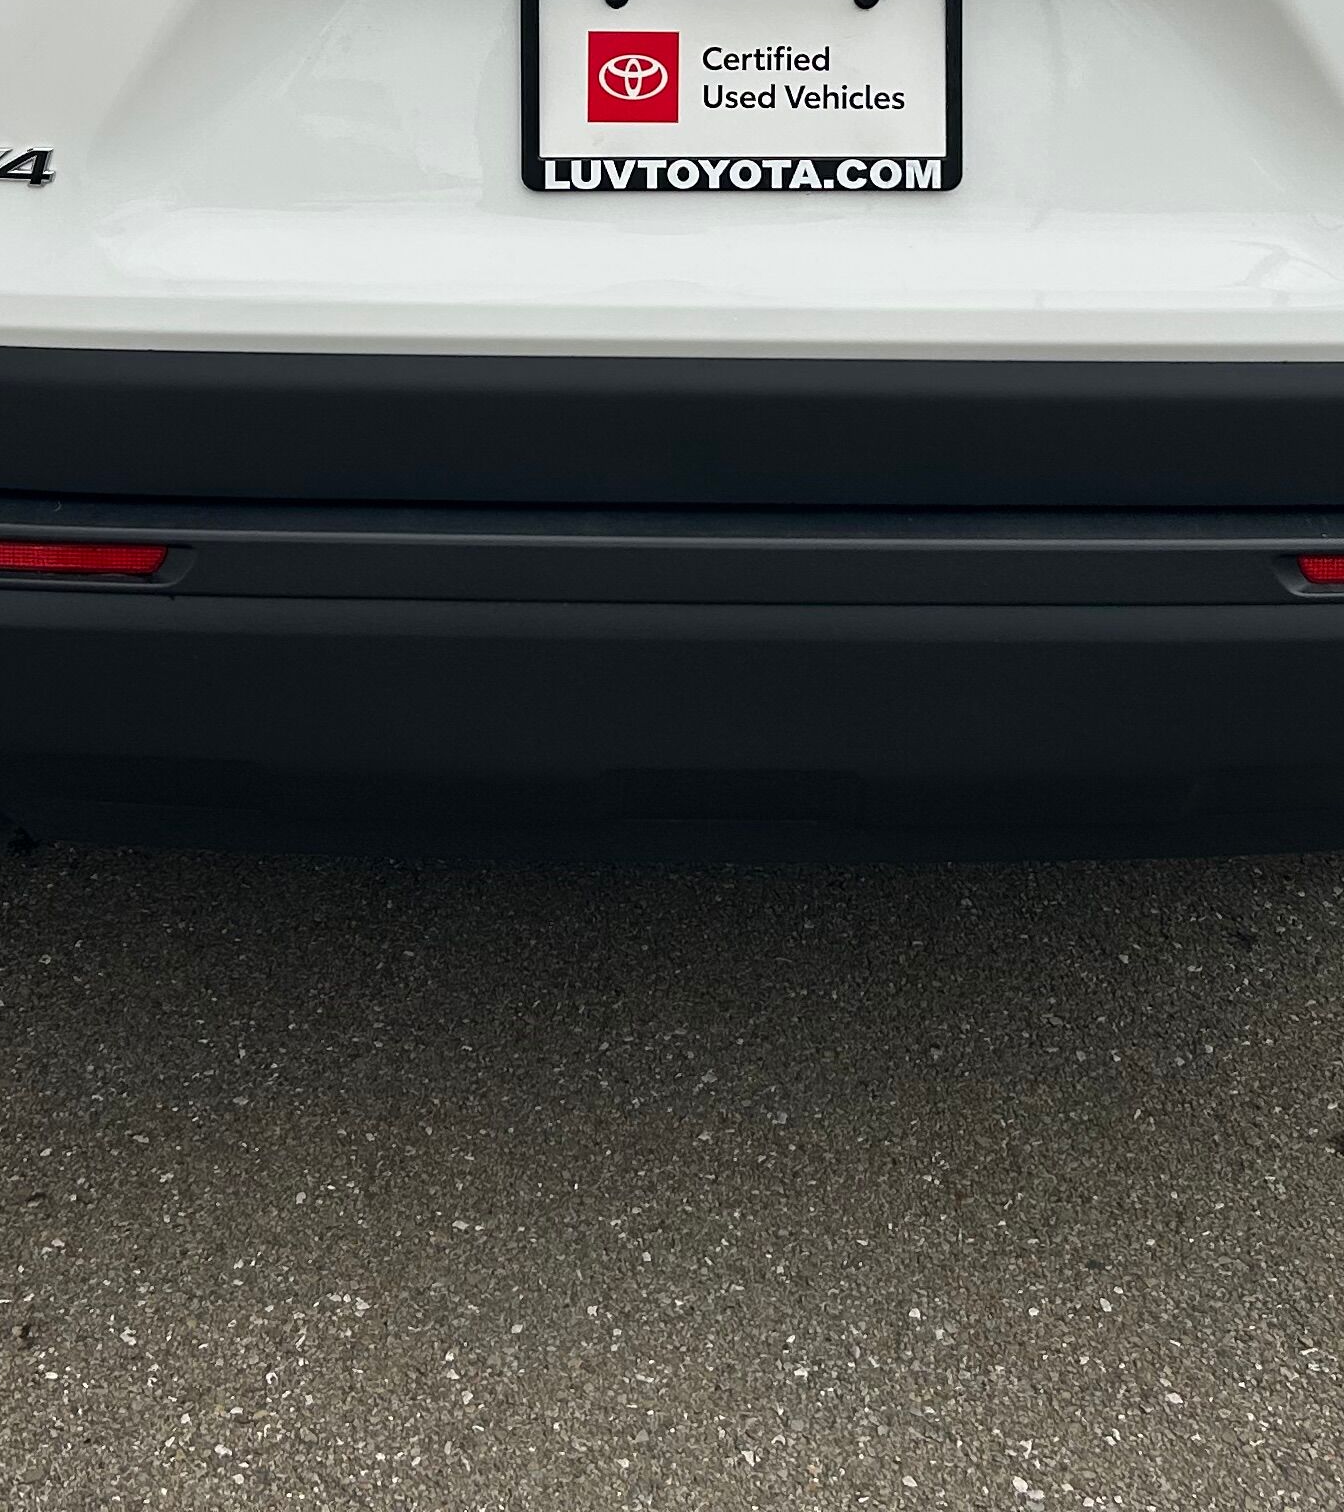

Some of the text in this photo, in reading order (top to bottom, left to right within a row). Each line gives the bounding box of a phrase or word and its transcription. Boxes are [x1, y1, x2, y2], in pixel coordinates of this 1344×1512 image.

[702, 46, 831, 72] Certified
[702, 84, 905, 110] Used Vehicles
[544, 159, 942, 190] LUVTOYOTA.COM
